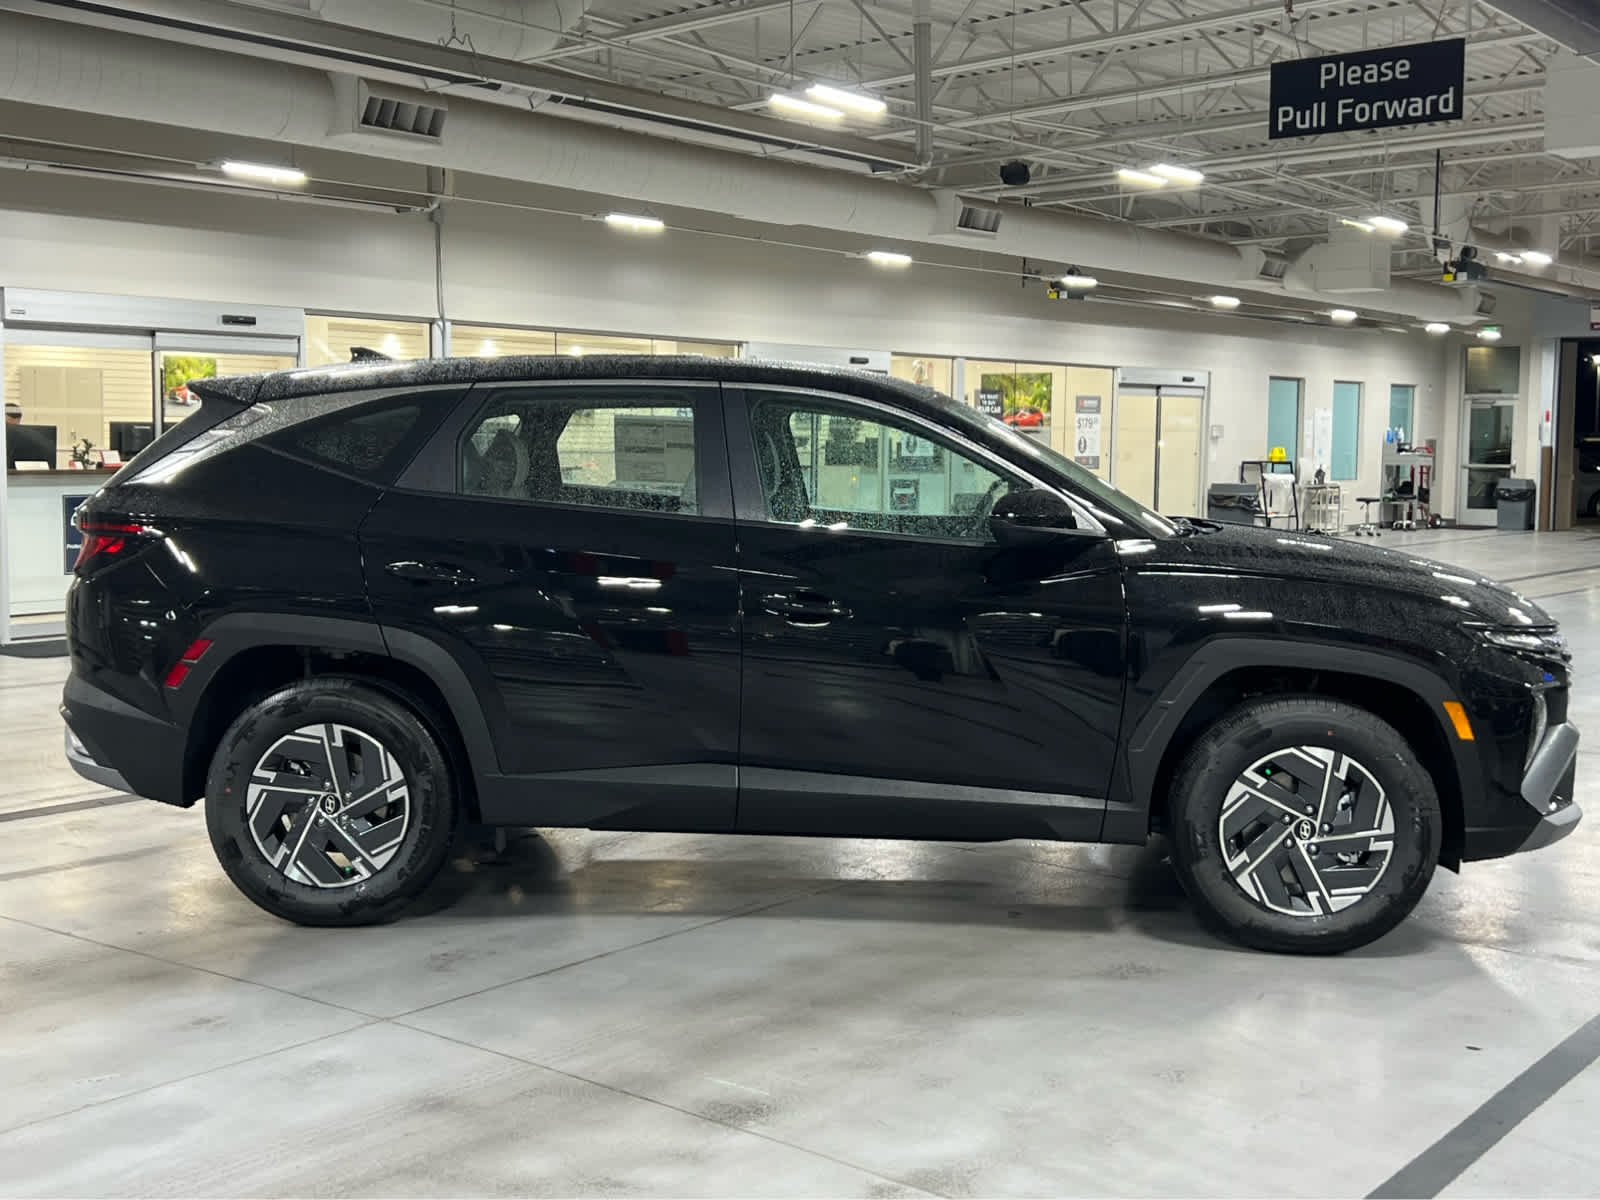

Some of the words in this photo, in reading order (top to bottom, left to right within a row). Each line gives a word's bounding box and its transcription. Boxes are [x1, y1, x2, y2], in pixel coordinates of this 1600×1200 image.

[1320, 59, 1411, 89] Please
[1277, 101, 1326, 132] Pull
[1337, 86, 1455, 125] Forward
